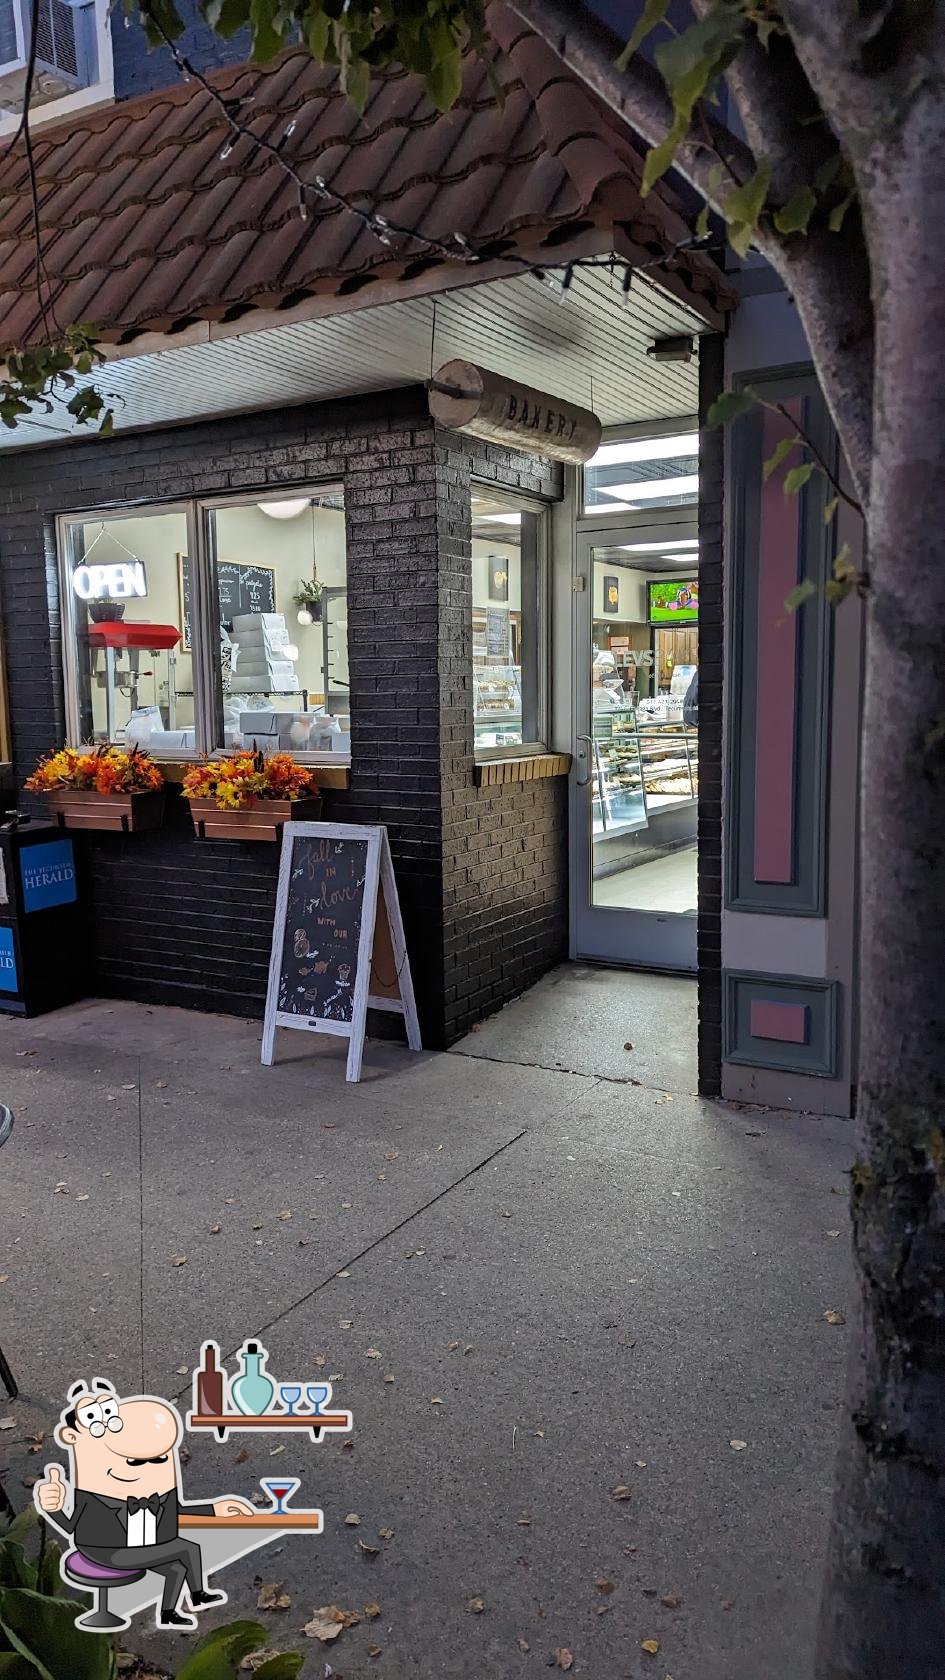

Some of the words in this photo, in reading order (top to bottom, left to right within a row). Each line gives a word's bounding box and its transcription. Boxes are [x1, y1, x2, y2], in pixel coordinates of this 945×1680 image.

[508, 394, 577, 441] BAKERY
[73, 563, 147, 599] OPEN
[299, 840, 333, 881] fall
[326, 867, 336, 878] IN
[25, 869, 73, 889] HERALD
[320, 882, 357, 911] love
[317, 917, 336, 927] WITH
[334, 929, 348, 939] OUR
